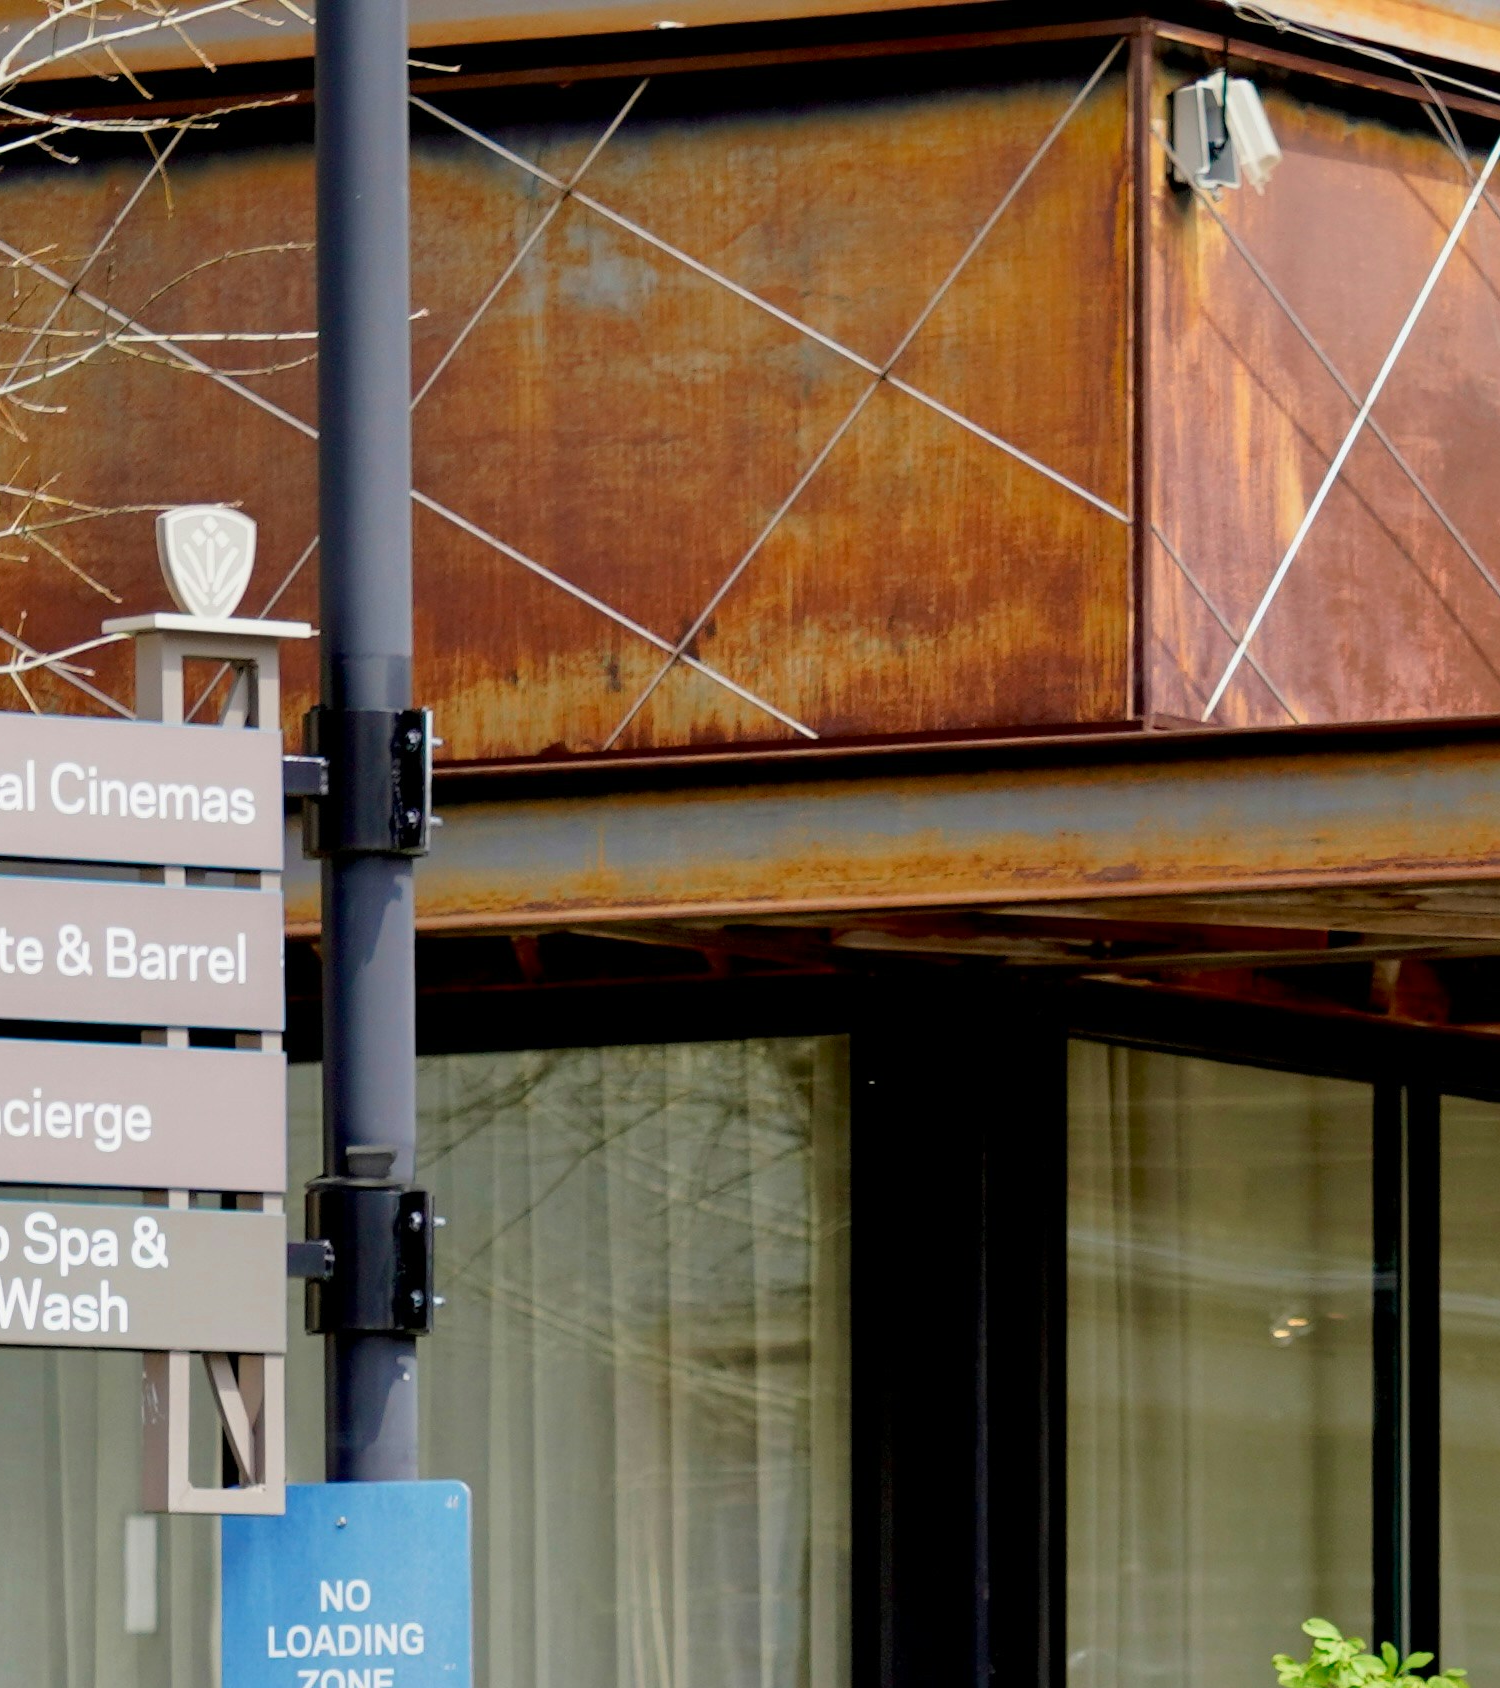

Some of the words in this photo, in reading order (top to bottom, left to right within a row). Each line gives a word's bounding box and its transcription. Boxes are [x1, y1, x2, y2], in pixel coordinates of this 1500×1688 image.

[50, 762, 256, 825] Cinemas
[56, 924, 93, 978] &
[106, 926, 246, 984] Barrel
[23, 1212, 119, 1277] Spa
[131, 1216, 169, 1269] &
[319, 1579, 371, 1612] NO
[267, 1623, 425, 1659] LOADING
